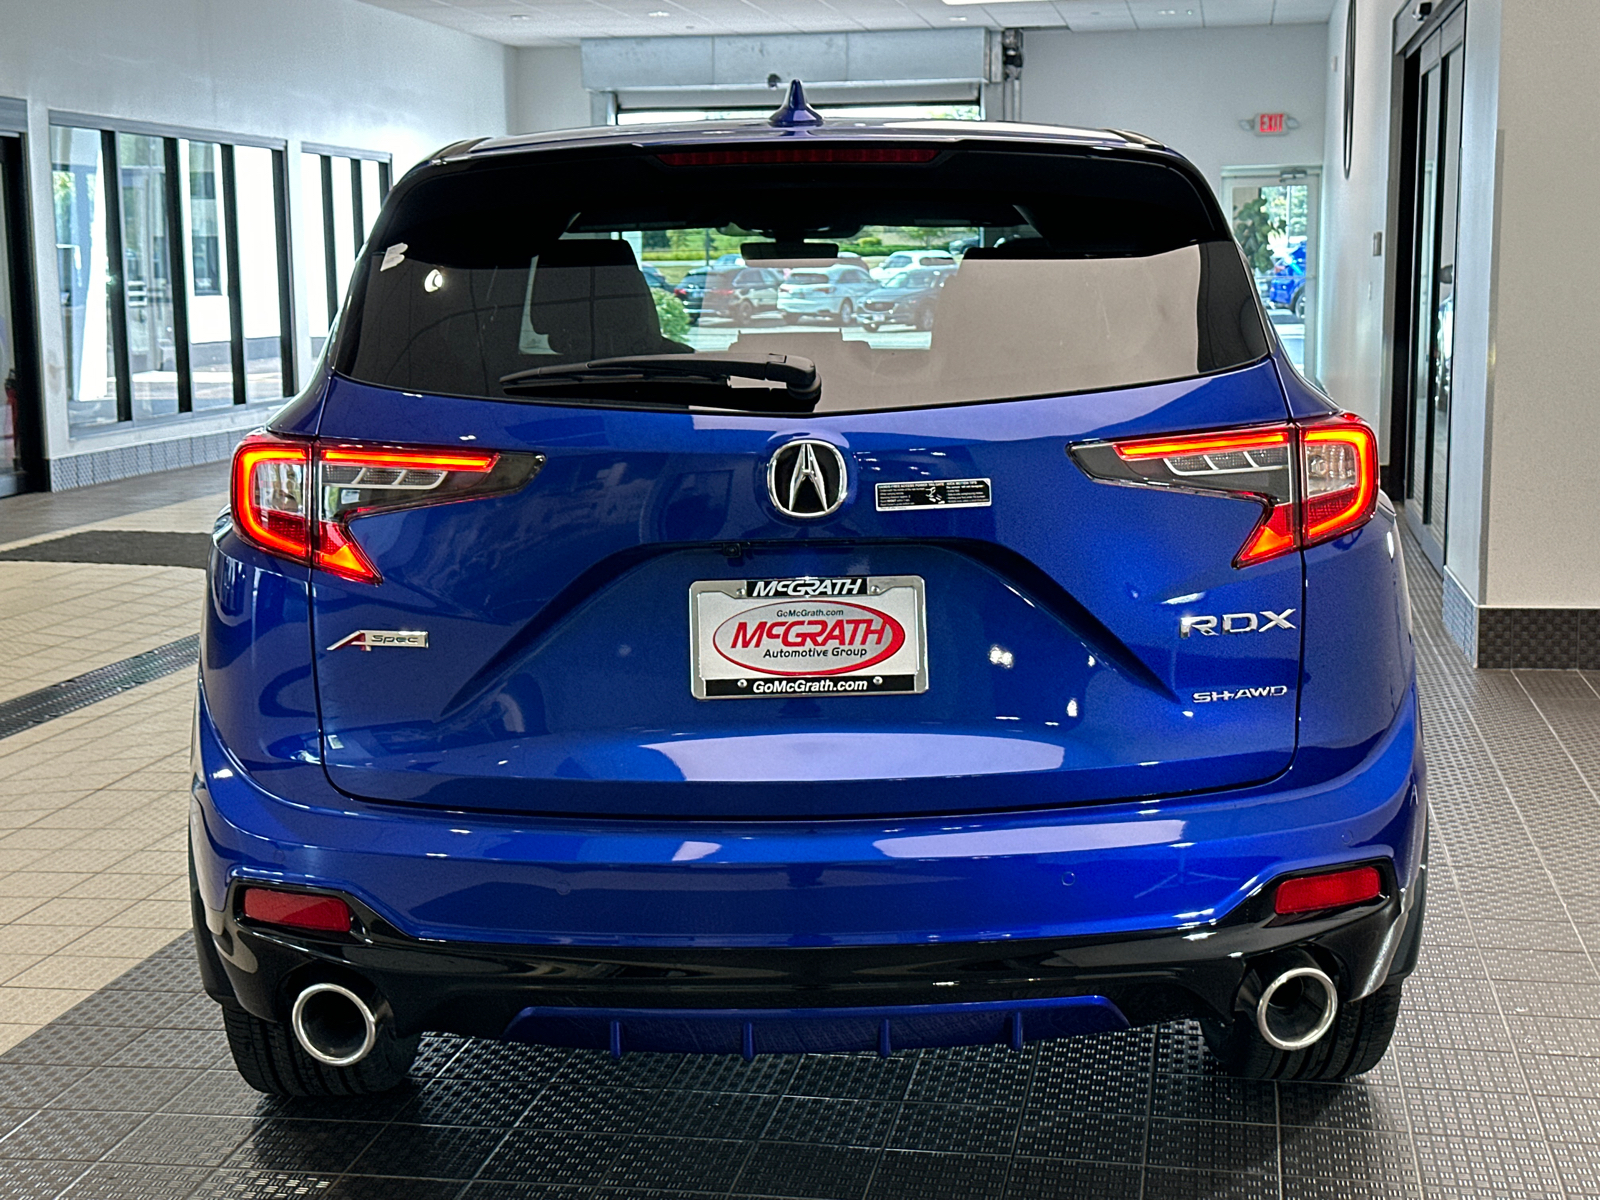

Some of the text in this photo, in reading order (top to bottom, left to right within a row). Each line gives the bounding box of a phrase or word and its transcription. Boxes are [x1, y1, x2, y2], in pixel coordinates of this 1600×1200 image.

[1259, 113, 1284, 132] EXIT
[776, 608, 844, 618] GoMcGrath.com
[1180, 608, 1297, 639] RDX
[763, 647, 867, 659] Automotive Group
[753, 679, 868, 694] GoMcGrath.com
